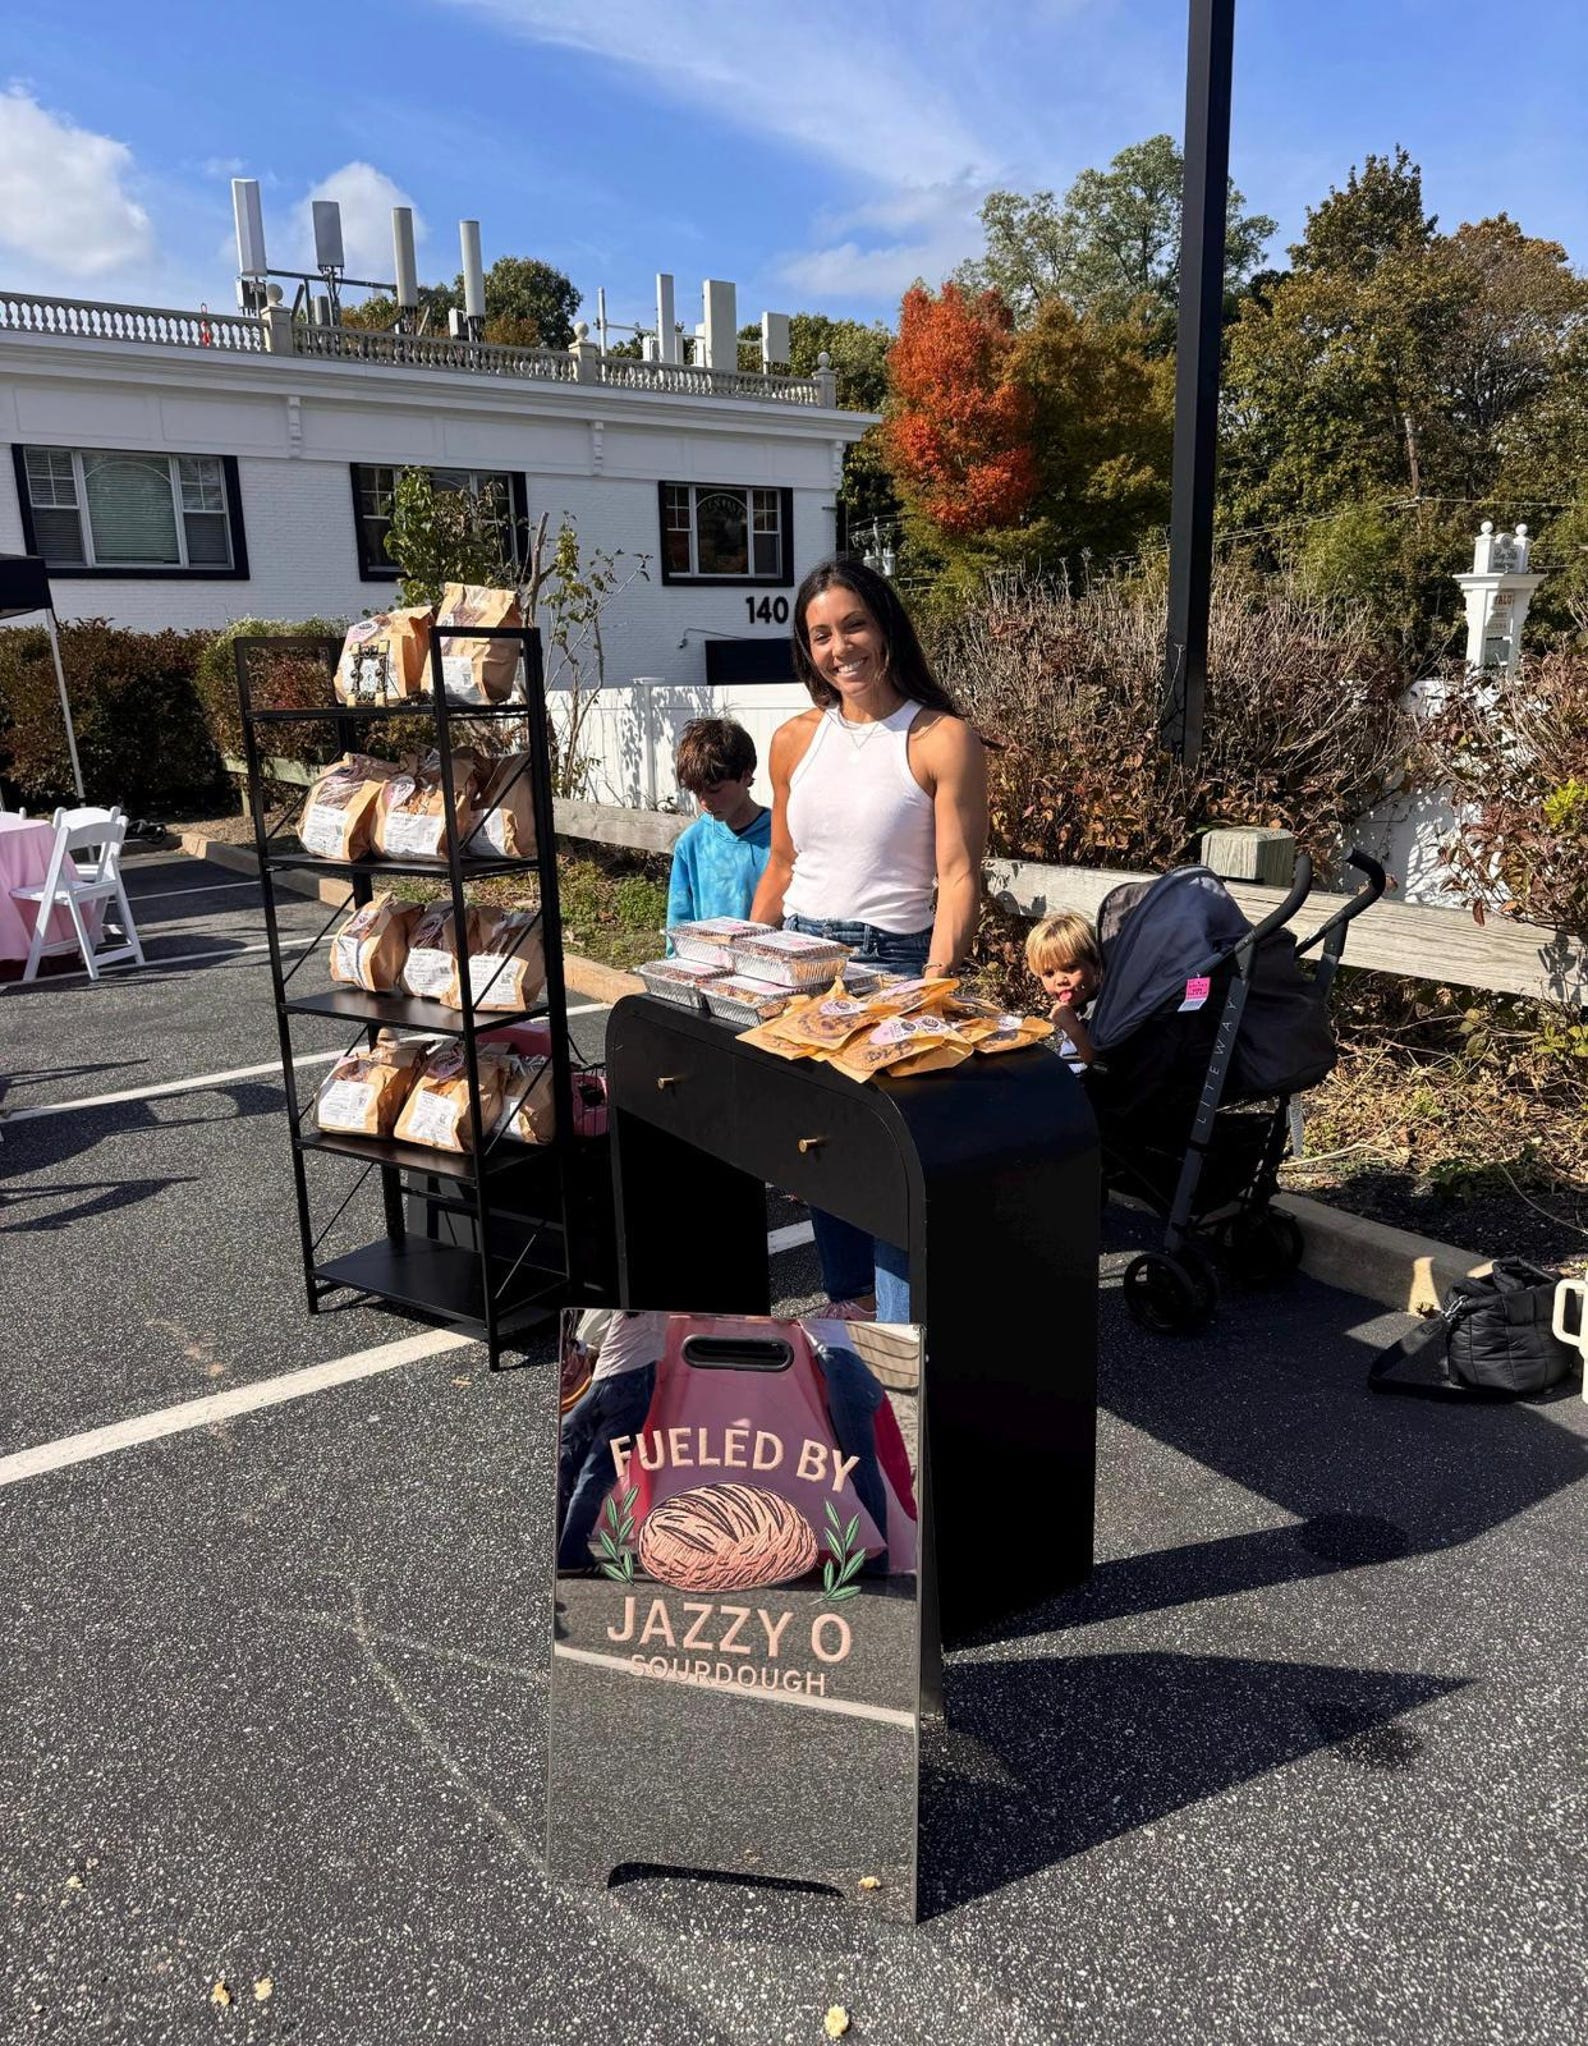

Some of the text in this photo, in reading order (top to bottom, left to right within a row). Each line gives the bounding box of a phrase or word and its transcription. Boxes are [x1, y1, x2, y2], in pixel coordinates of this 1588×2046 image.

[746, 597, 789, 624] 140
[796, 1439, 860, 1492] BY
[607, 1596, 851, 1663] JAZZY O
[630, 1654, 826, 1696] SOURDOUGH
